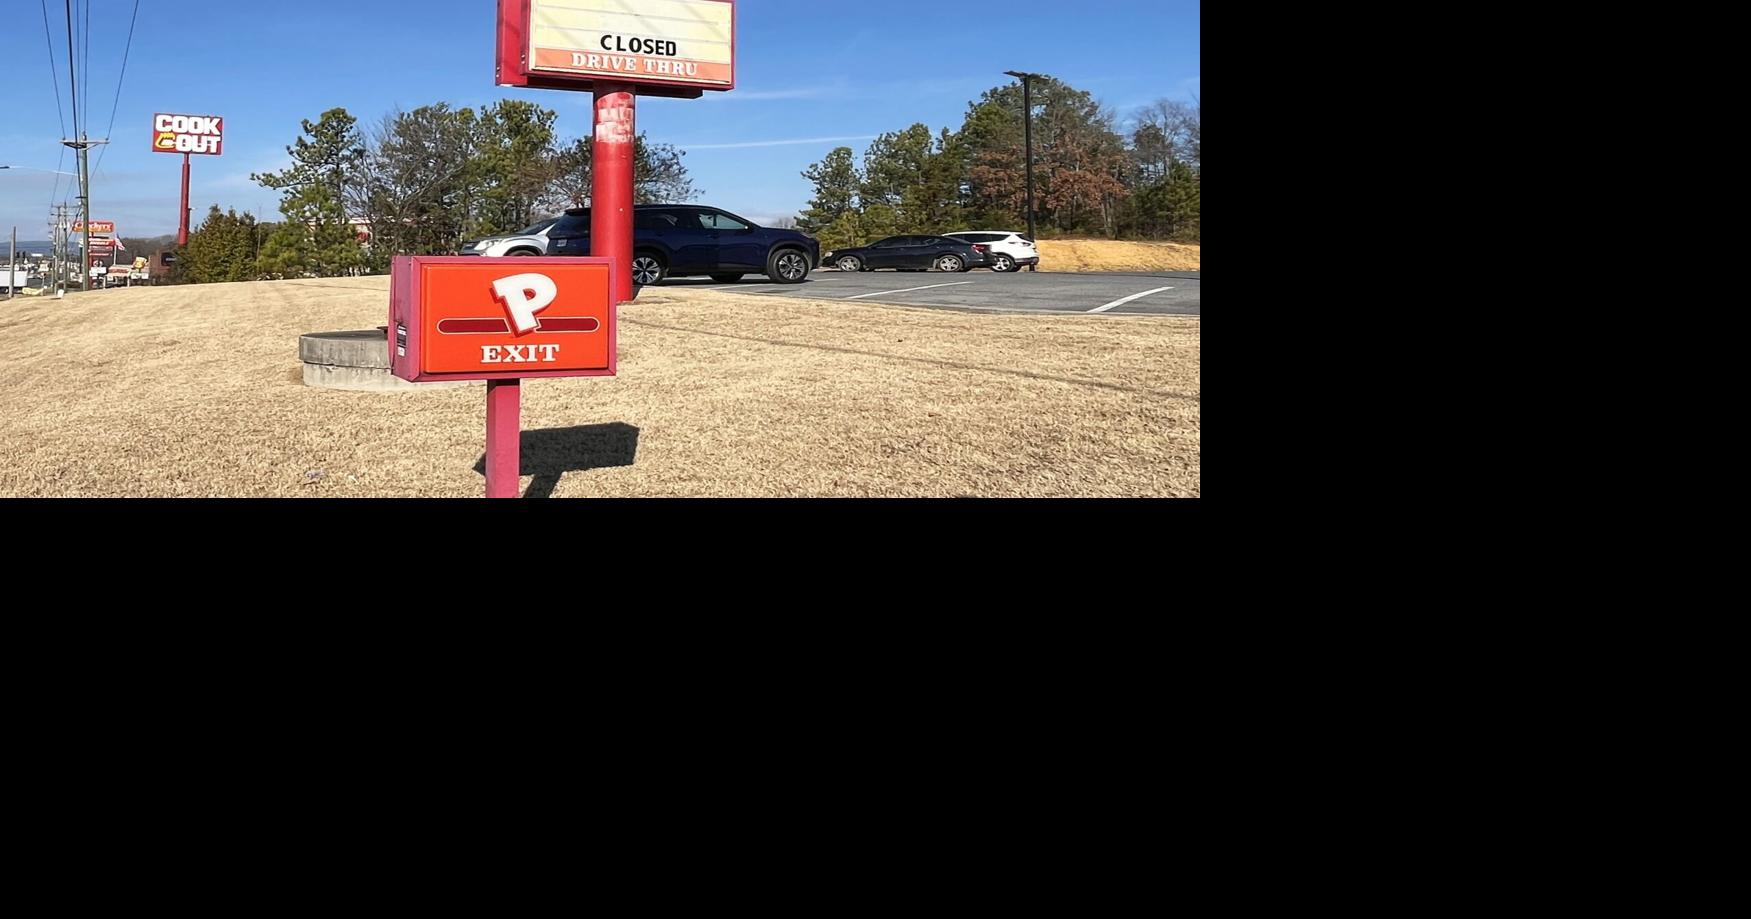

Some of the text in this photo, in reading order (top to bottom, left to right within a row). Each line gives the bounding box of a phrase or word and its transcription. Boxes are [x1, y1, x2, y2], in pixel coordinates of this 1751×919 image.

[600, 34, 677, 57] CLOSED
[571, 52, 699, 76] DRIVE THRU
[155, 114, 221, 135] COOK
[176, 134, 221, 153] OUT
[490, 272, 558, 335] P
[481, 344, 560, 363] EXIT
